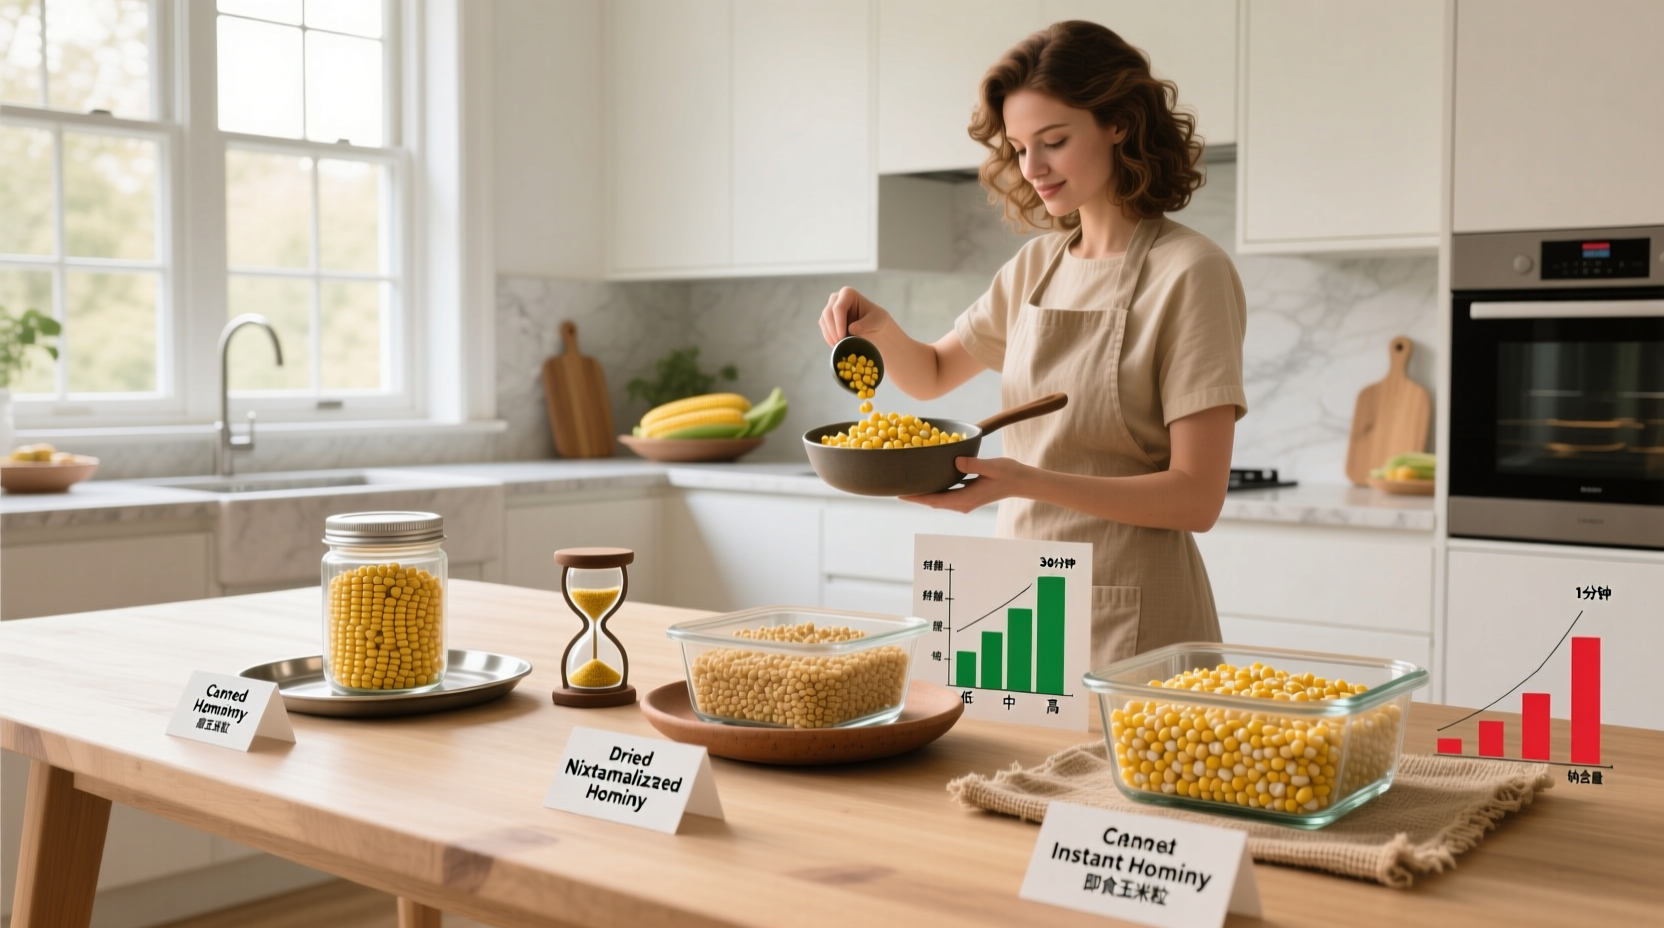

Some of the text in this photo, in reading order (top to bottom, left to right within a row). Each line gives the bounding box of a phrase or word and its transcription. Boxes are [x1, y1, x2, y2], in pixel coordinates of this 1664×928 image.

[1003, 694, 1015, 710] 中
[1047, 699, 1059, 714] 高
[609, 746, 654, 767] Dried
[586, 783, 647, 813] Hominy
[1051, 842, 1212, 892] Instant Hominy
